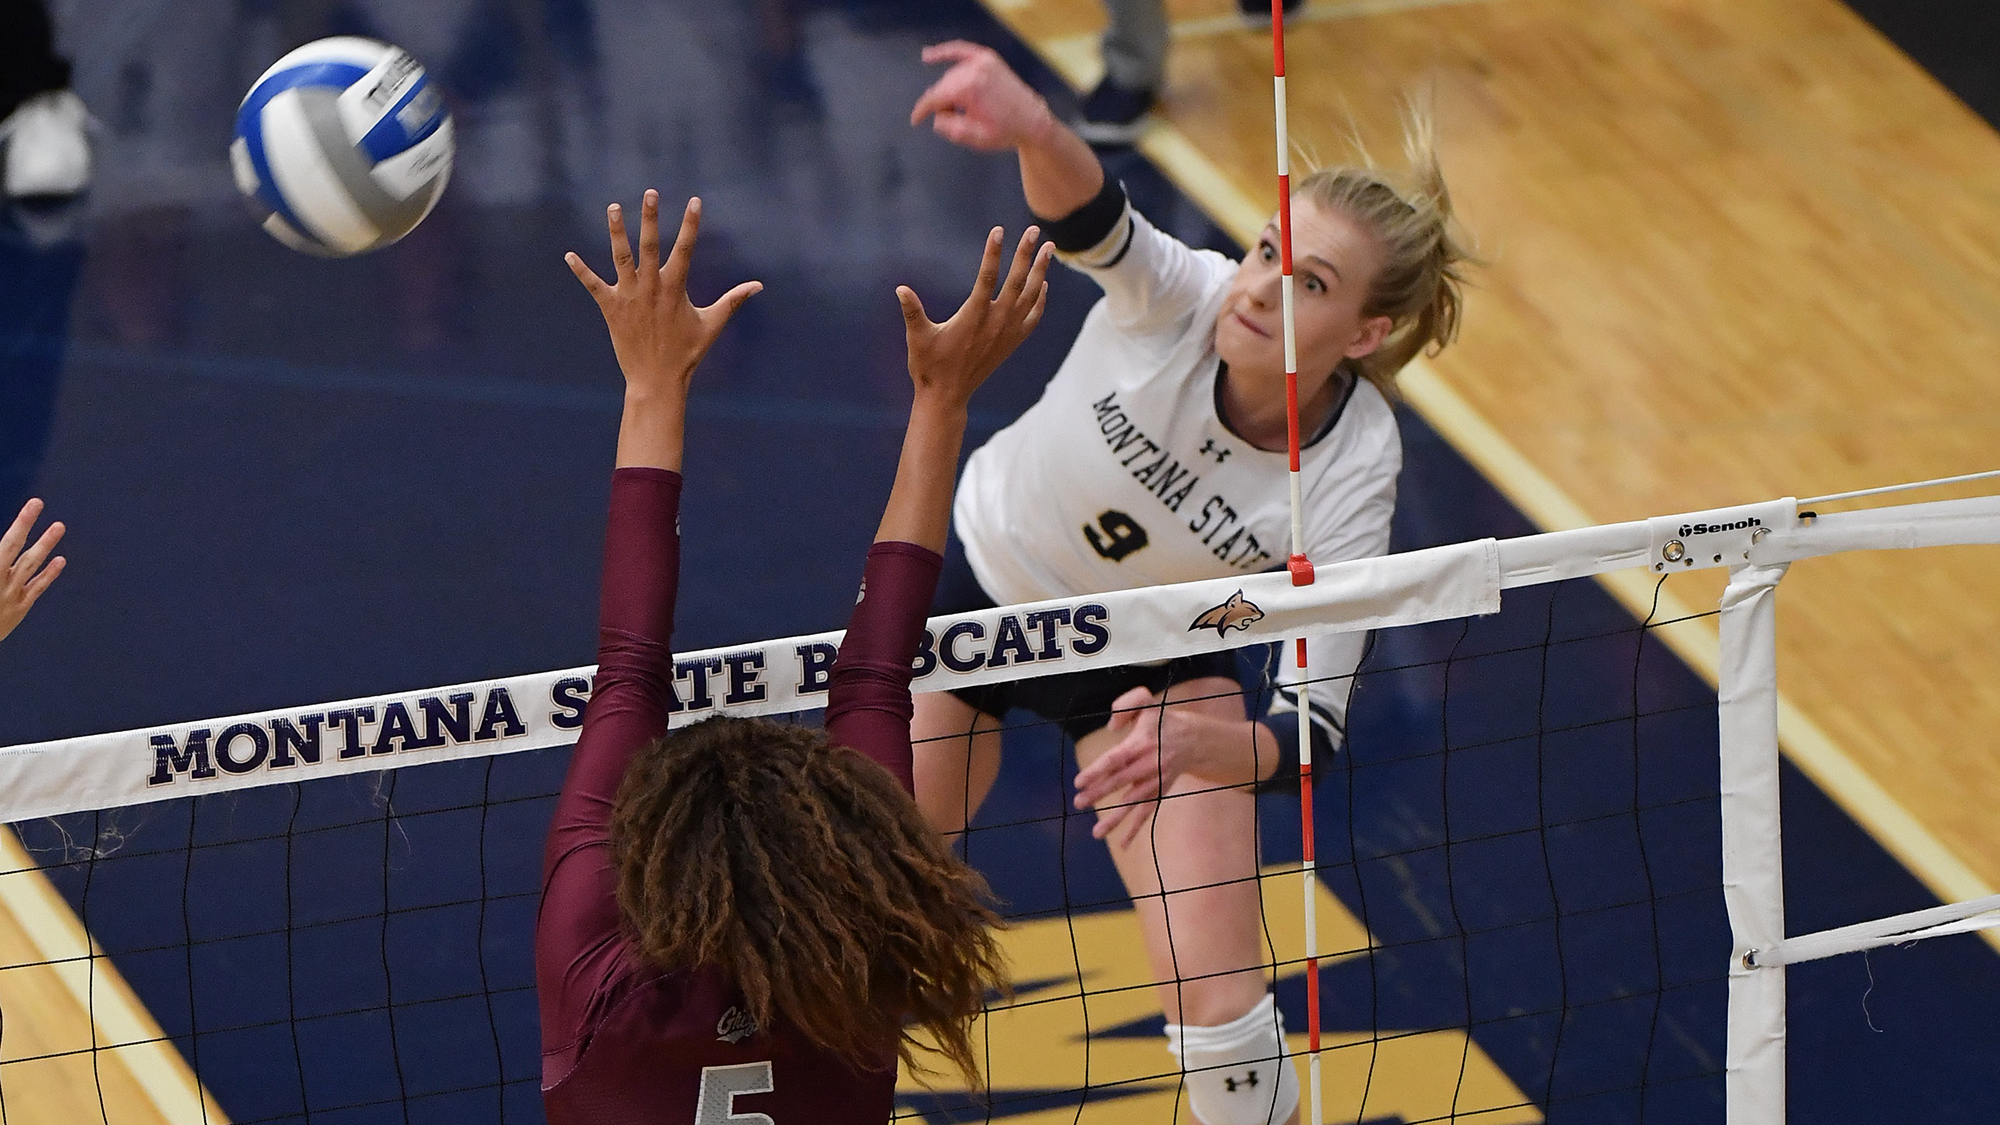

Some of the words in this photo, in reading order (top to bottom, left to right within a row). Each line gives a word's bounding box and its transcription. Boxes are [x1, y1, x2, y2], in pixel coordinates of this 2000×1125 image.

[1093, 391, 1199, 513] MONTANA
[1082, 508, 1149, 562] 9
[1693, 517, 1761, 535] Senoh
[146, 683, 527, 788] MONTANA
[549, 648, 769, 731] STE
[794, 602, 1110, 696] BBCATS
[695, 1060, 775, 1125] 5
